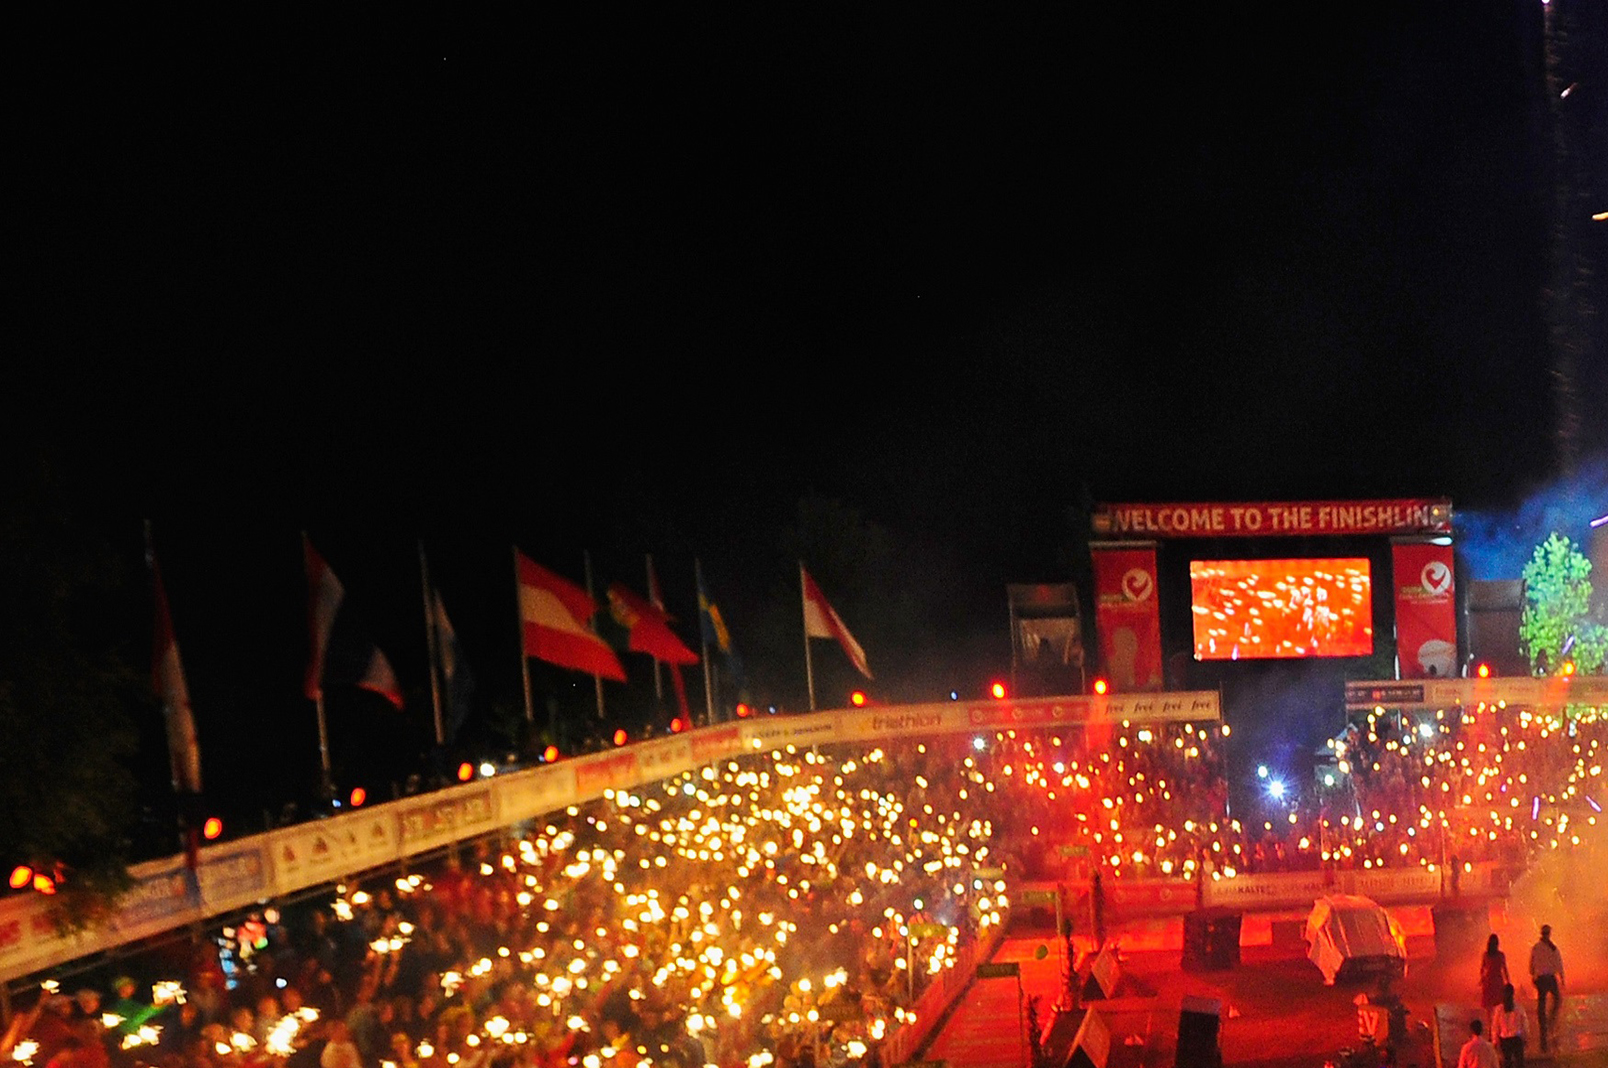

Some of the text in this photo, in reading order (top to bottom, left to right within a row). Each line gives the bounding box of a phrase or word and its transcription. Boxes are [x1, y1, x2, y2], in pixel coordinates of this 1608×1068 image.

[1113, 507, 1225, 532] WELCOME
[1230, 507, 1262, 530] TO
[1267, 506, 1312, 529] THE
